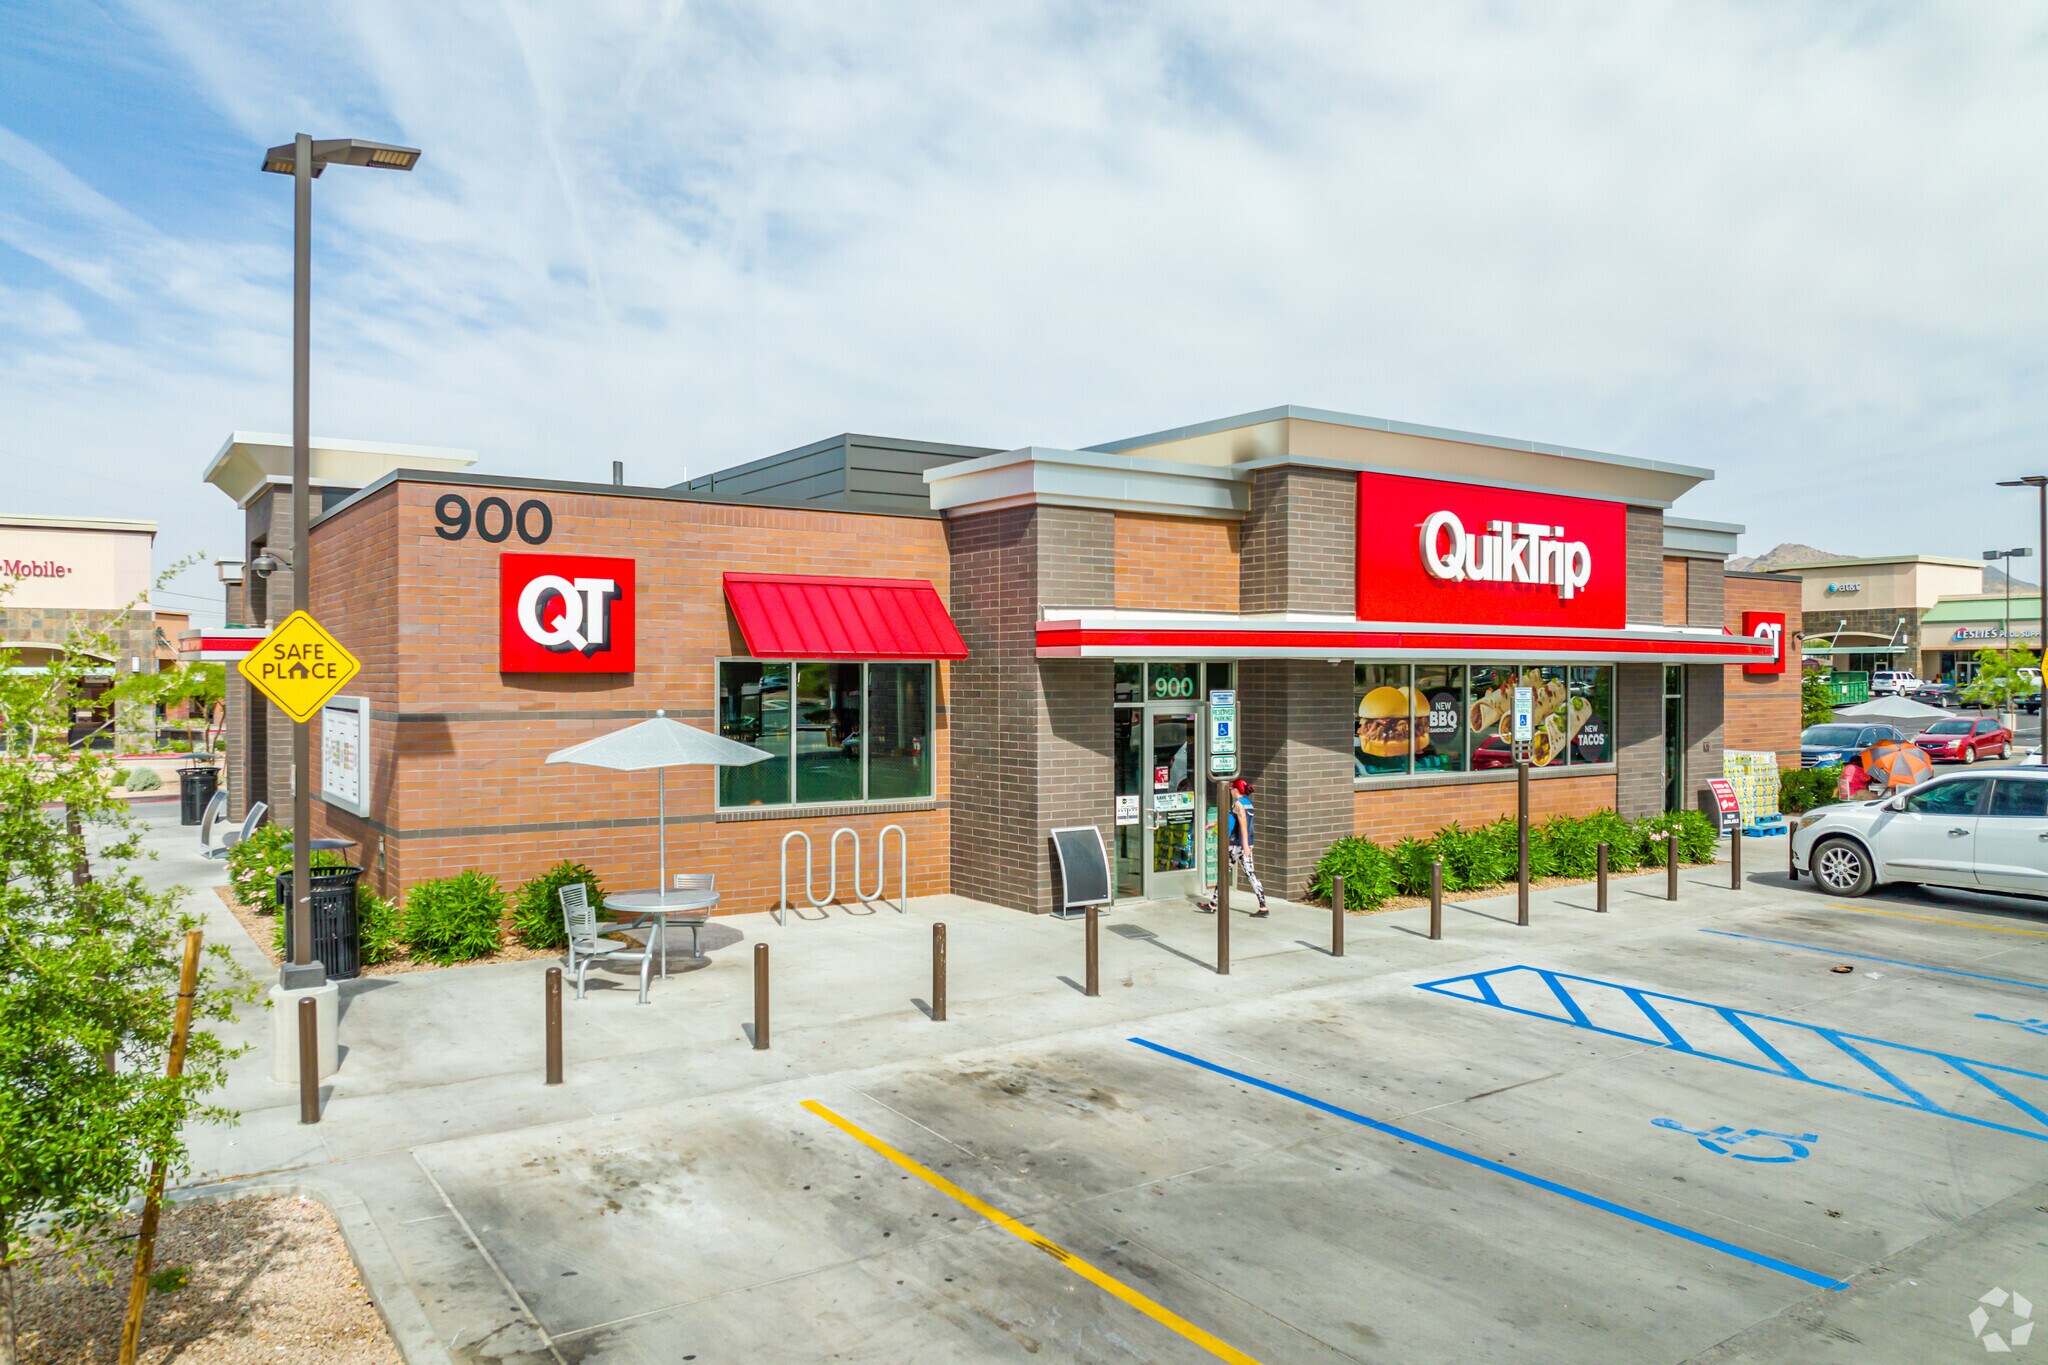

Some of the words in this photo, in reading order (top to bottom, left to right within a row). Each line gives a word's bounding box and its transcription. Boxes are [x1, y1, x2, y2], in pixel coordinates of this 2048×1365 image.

[435, 493, 553, 545] 900
[1419, 510, 1592, 600] QuikTrip
[517, 574, 617, 654] QT
[1956, 627, 1998, 640] LESLIE'S
[273, 643, 325, 661] SAFE
[1155, 677, 1194, 698] 900
[1435, 701, 1452, 711] NEW
[1429, 710, 1458, 729] BBQ
[1584, 724, 1599, 733] NEW
[1577, 733, 1605, 746] TACOS
